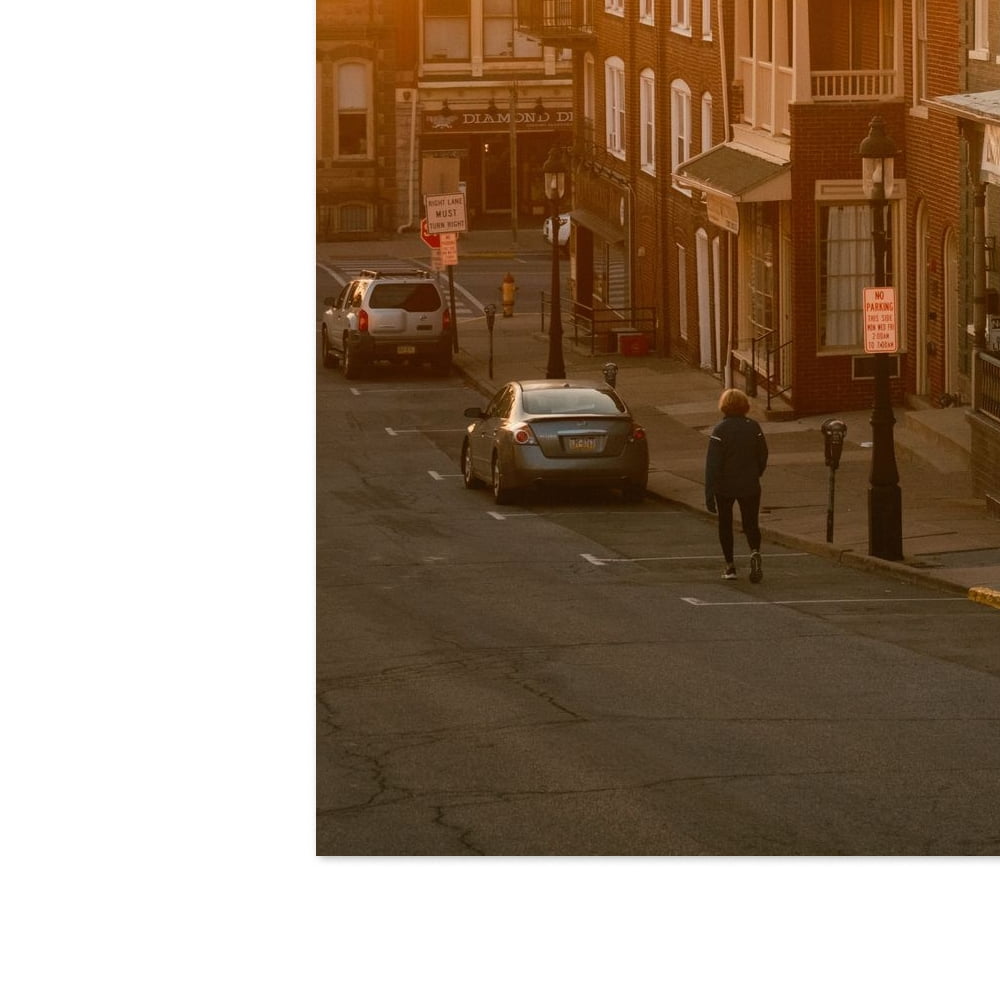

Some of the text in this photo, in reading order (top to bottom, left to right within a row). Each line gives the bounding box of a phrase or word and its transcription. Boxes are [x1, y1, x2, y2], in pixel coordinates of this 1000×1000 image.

[447, 198, 462, 206] LANE
[435, 209, 456, 217] MUST
[429, 222, 445, 230] TURN
[447, 220, 464, 228] RIGHT
[874, 290, 884, 300] NO
[866, 302, 893, 312] PARKING
